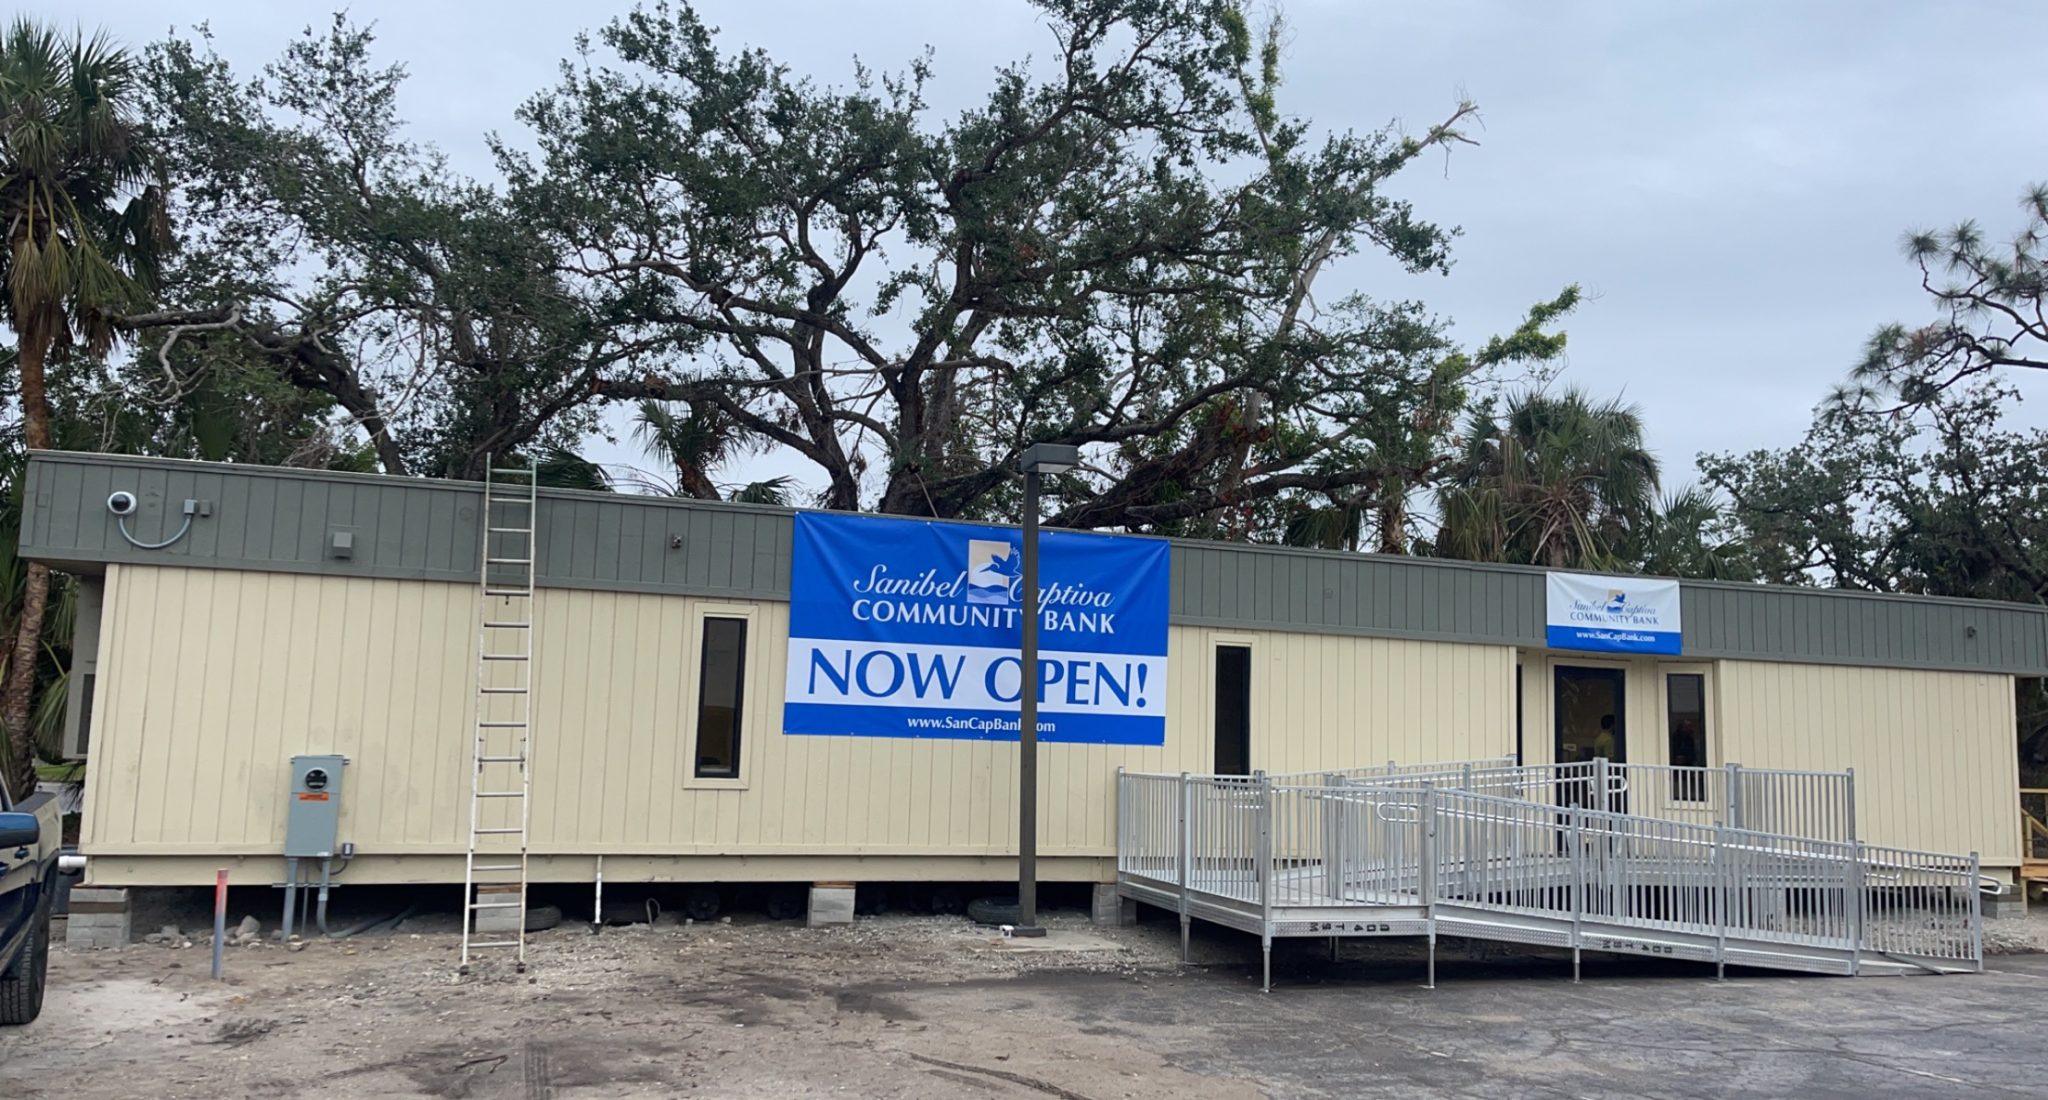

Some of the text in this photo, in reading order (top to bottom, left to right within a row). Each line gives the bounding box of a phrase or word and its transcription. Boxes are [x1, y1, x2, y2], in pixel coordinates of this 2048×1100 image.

[853, 563, 967, 598] Sanibel
[852, 598, 1115, 634] COMMUNIT BANK
[1569, 611, 1660, 625] COMMUNITY BANK
[1576, 632, 1656, 642] www.SanCapBank.com
[808, 647, 1148, 708] NOW OPEN!
[907, 716, 1056, 734] www.SanCapBanom
